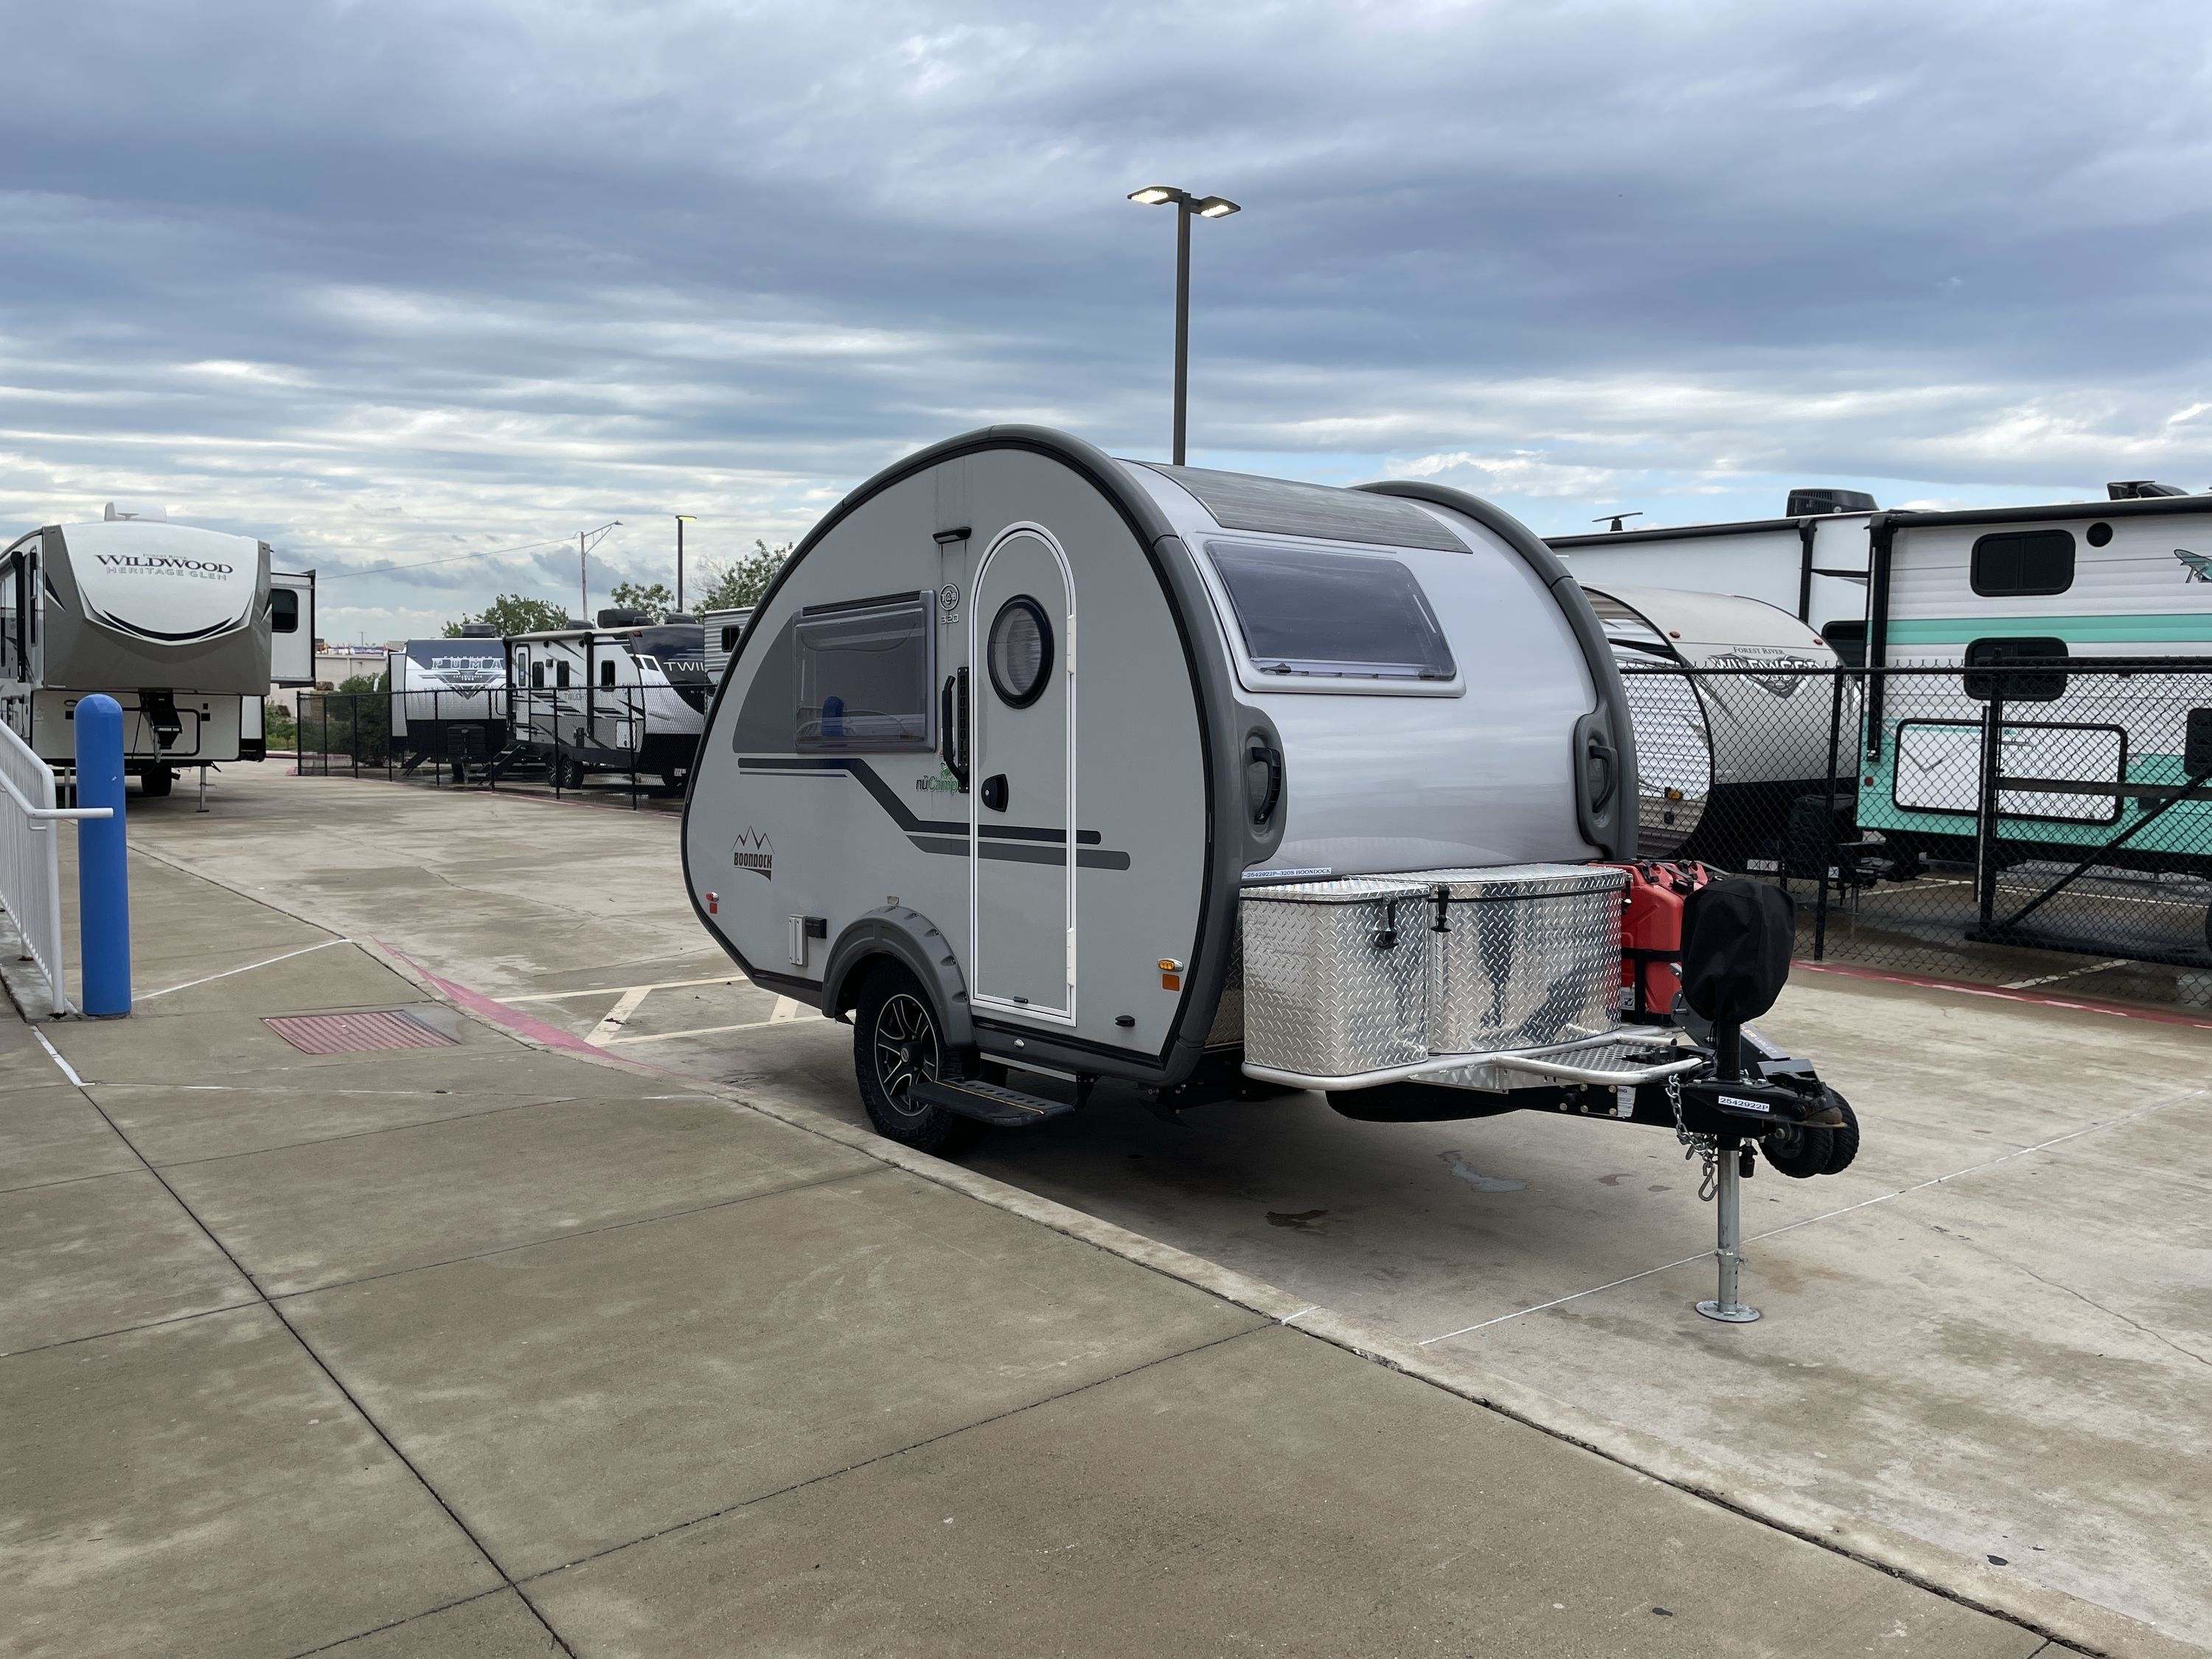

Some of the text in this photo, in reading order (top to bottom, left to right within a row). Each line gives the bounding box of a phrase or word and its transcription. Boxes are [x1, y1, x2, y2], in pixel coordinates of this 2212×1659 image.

[94, 554, 233, 573] WILDWOOD
[106, 566, 227, 581] HERITAGE GLEN
[941, 613, 959, 625] 320
[431, 658, 504, 670] PUMA
[734, 852, 773, 869] BOONDOCK
[1719, 1097, 1769, 1110] 2542922P
